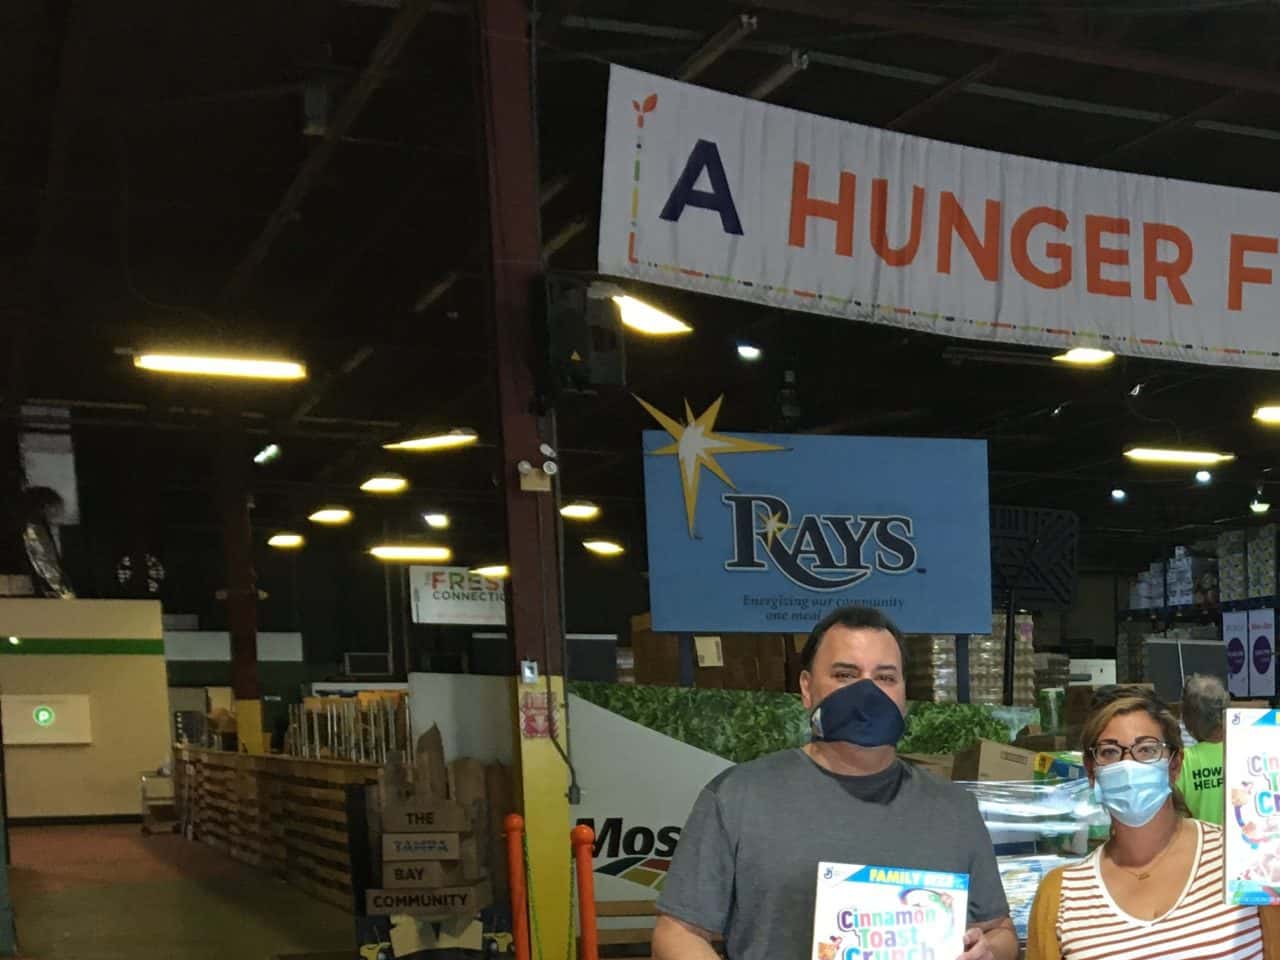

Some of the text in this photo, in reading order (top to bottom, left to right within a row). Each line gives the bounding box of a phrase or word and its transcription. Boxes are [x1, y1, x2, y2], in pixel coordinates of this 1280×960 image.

[659, 138, 744, 236] A
[788, 160, 1194, 305] HUNGER
[722, 493, 917, 592] RAYS
[1192, 767, 1222, 780] HOW
[405, 811, 435, 825] THE
[393, 867, 425, 881] BAY
[373, 894, 468, 909] COMMUNITY
[841, 907, 937, 930] Cinnamon
[859, 927, 918, 949] Toast
